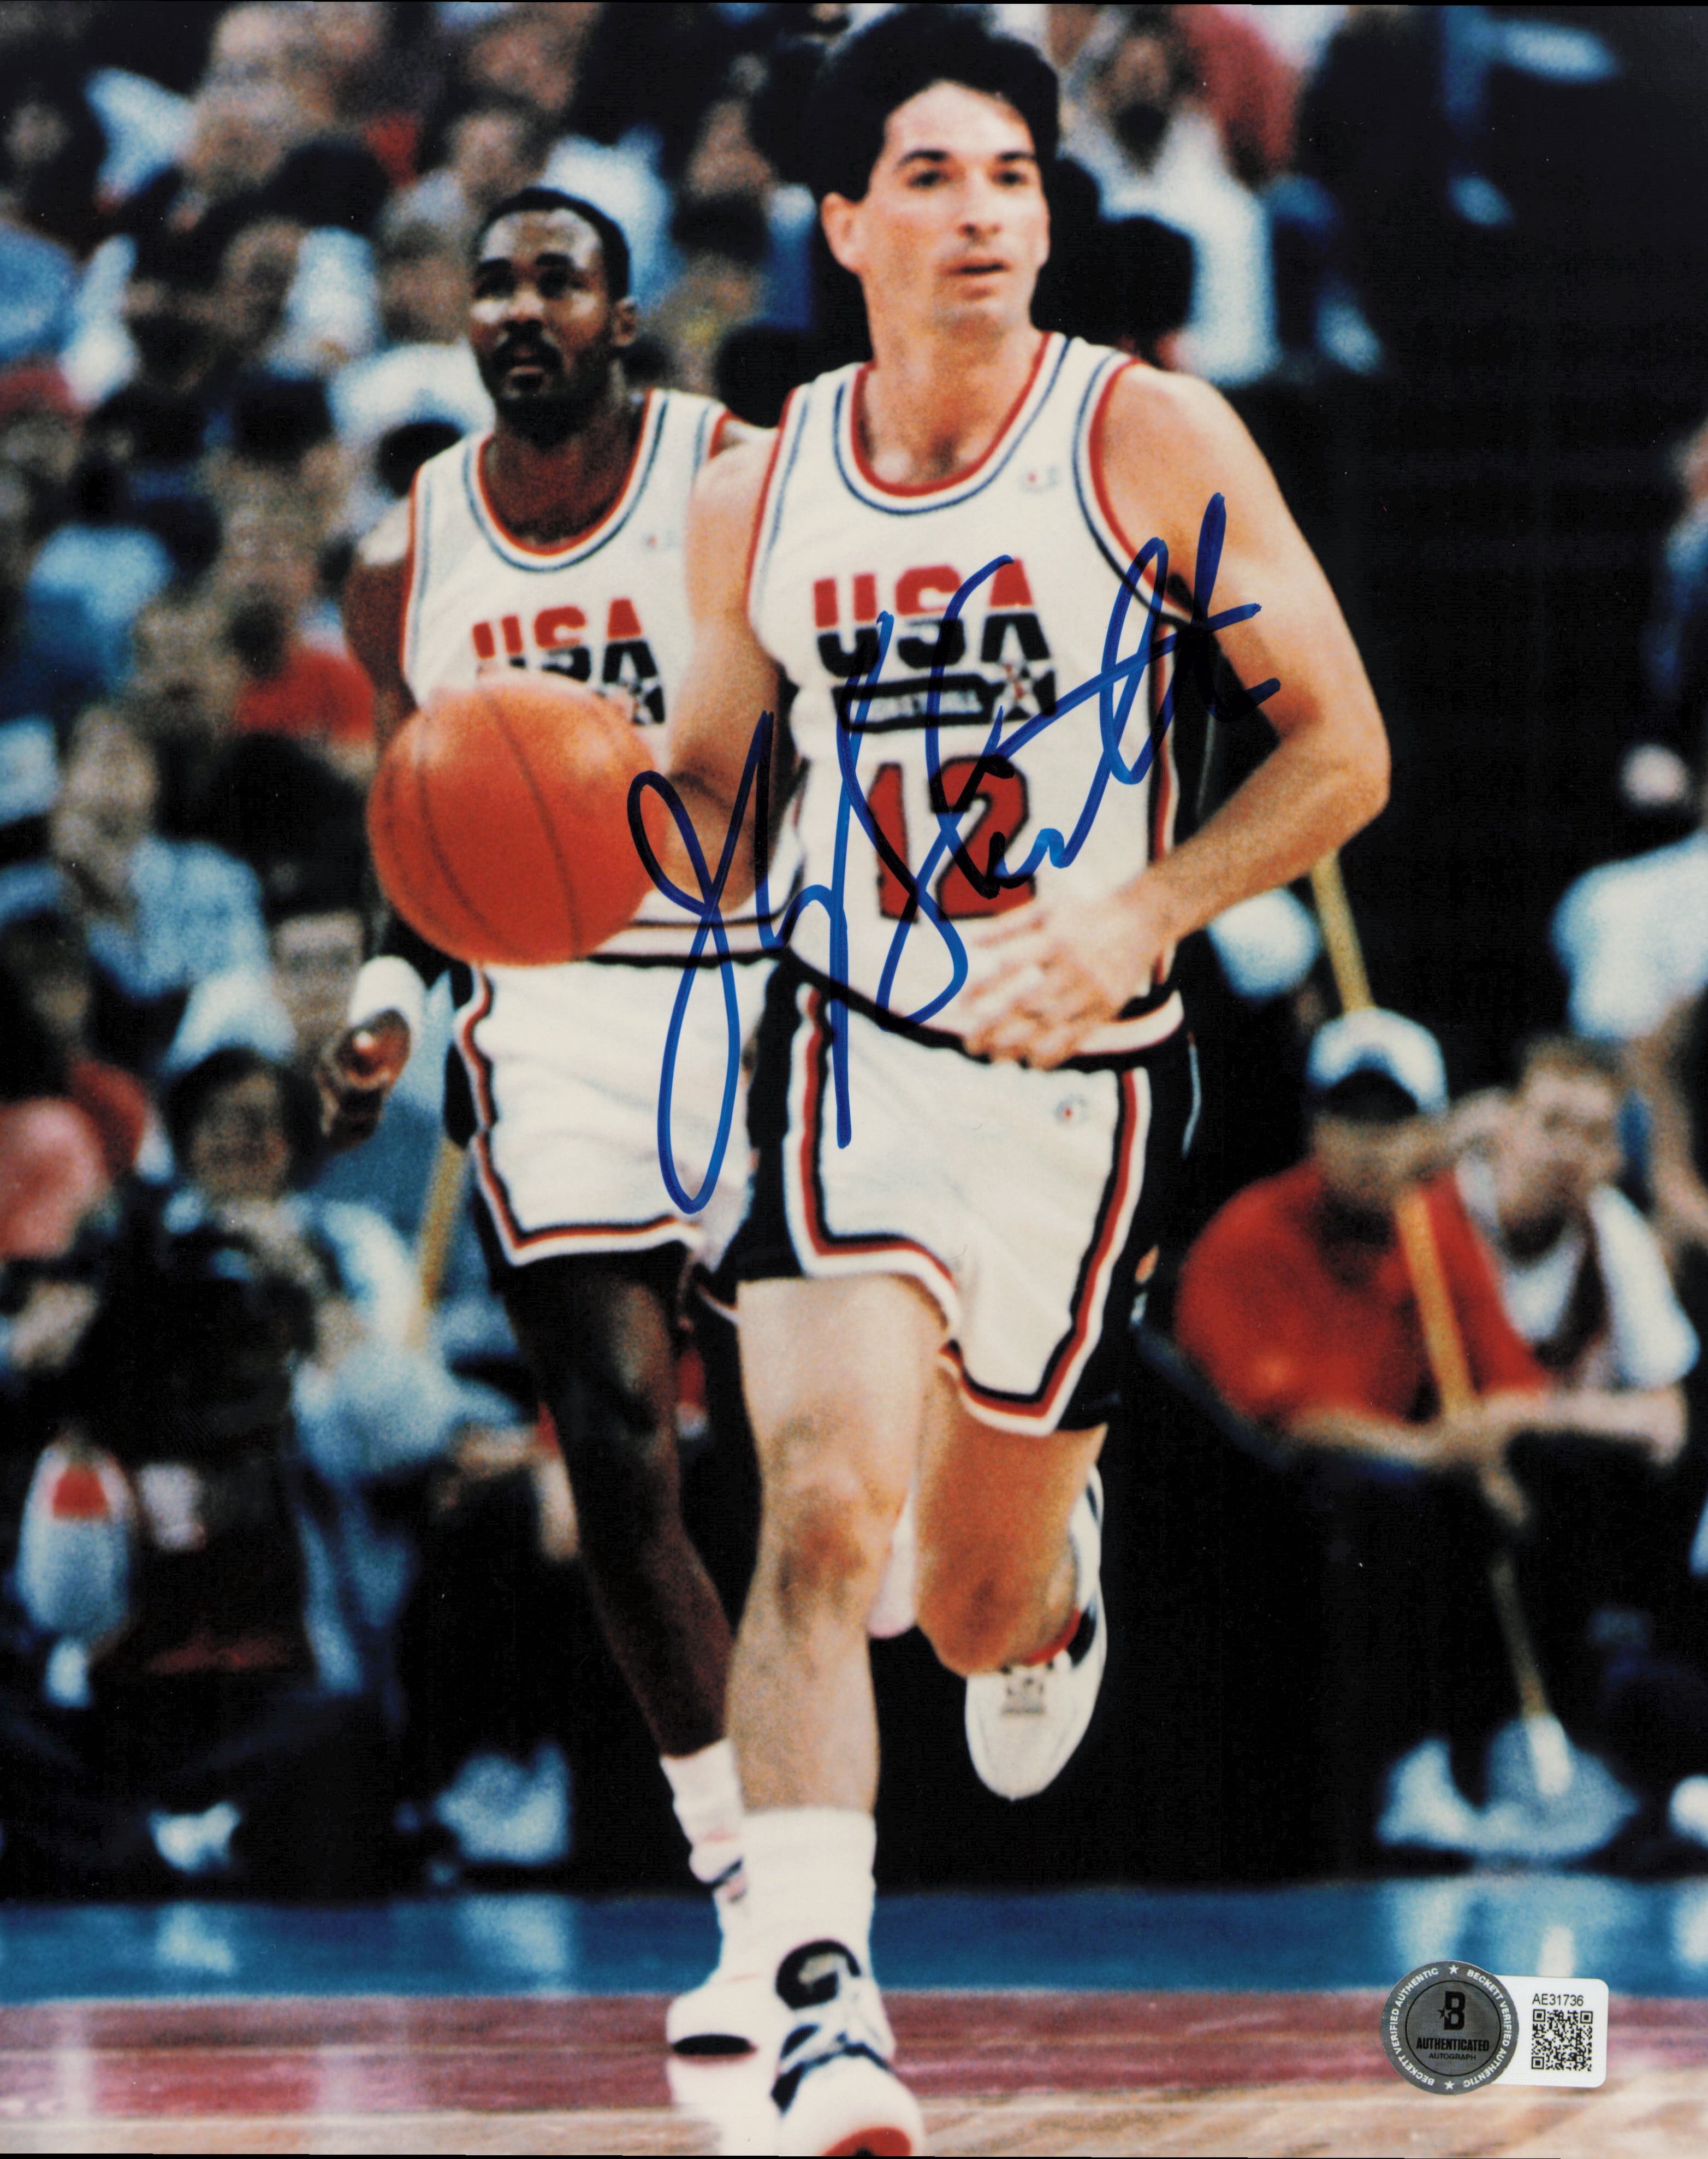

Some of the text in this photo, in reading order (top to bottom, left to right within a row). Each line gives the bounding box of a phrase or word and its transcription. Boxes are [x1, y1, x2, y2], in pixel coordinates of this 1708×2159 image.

[813, 557, 1051, 678] USA
[867, 755, 1036, 924] 12
[1390, 1968, 1439, 2086] BECKETT VERIFIED AUTHENTIC
[1416, 2037, 1490, 2052] AUTHENTICATED
[1429, 2052, 1476, 2061] AUTOGRAPH
[1463, 1969, 1512, 2087] BECKETT VERIFIED AUTHENTIC
[1532, 1993, 1584, 2007] AE31736
